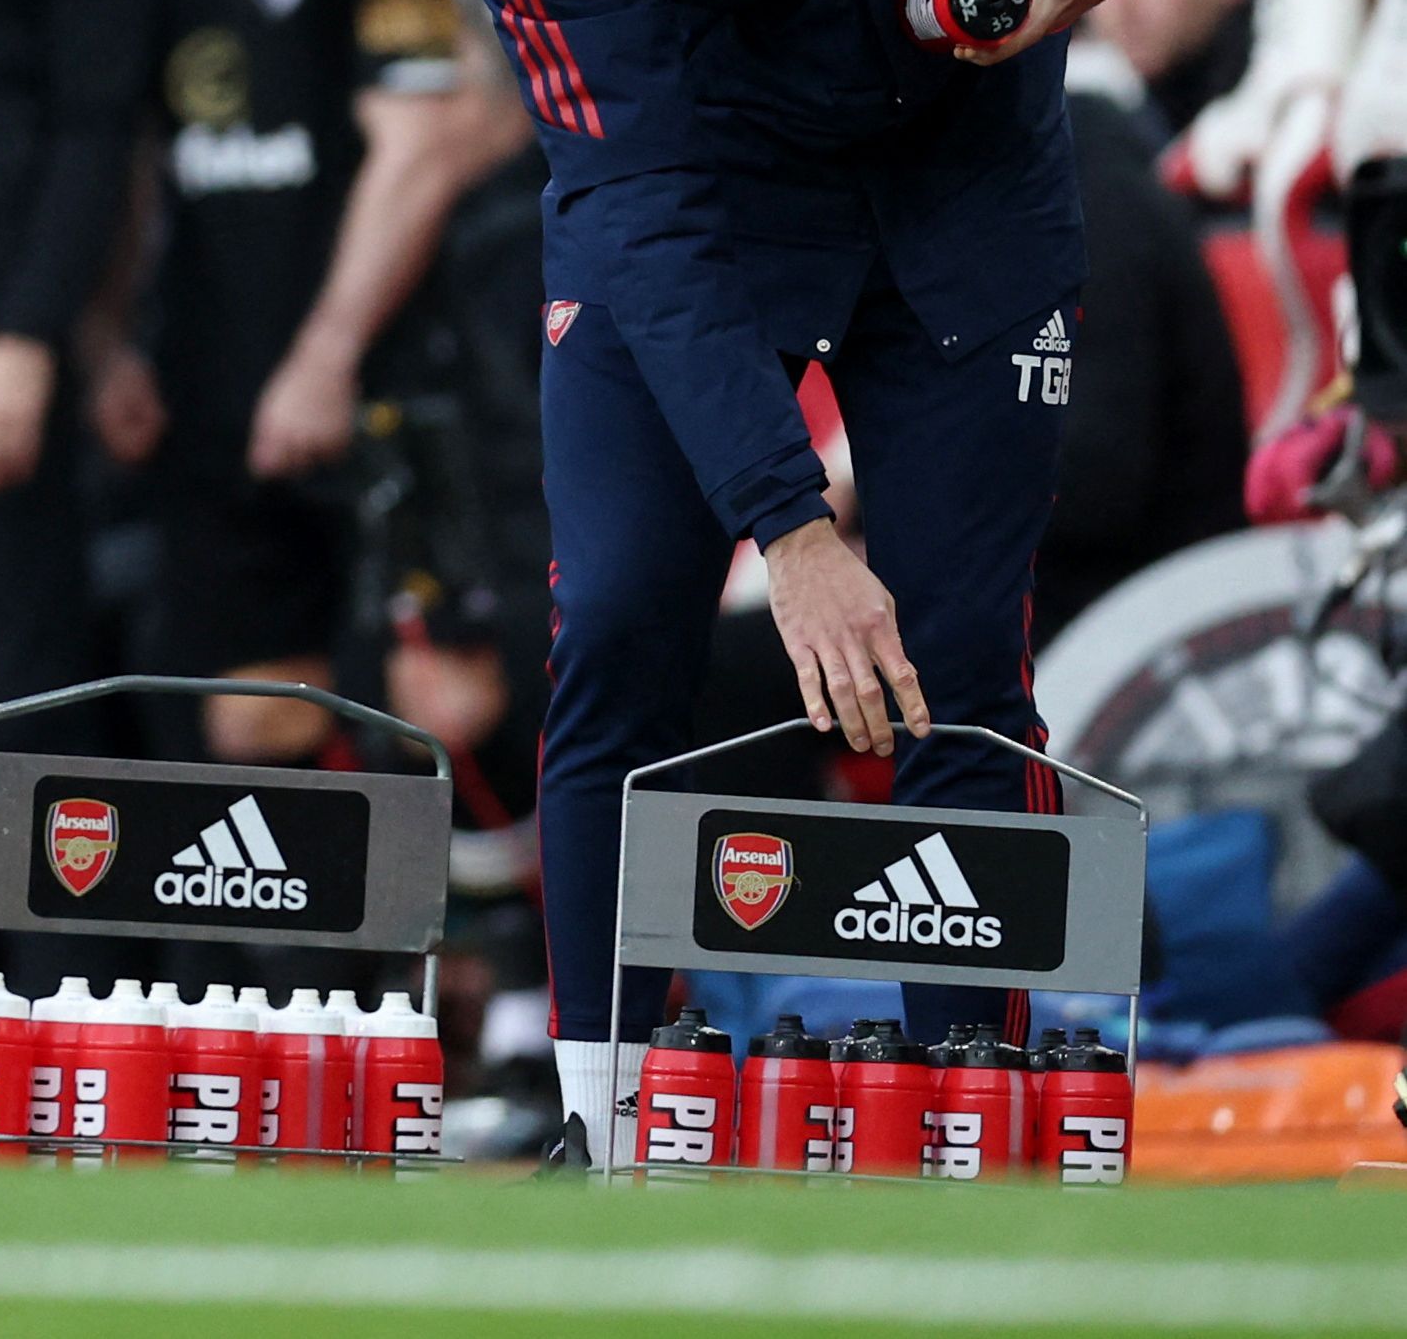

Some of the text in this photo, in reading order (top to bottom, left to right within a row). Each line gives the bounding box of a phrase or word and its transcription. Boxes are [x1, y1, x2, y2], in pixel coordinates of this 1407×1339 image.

[991, 12, 1014, 32] 35
[55, 813, 309, 911] Arsenal adidas
[723, 847, 1003, 949] Arsenal adidas
[647, 1093, 717, 1168] PR
